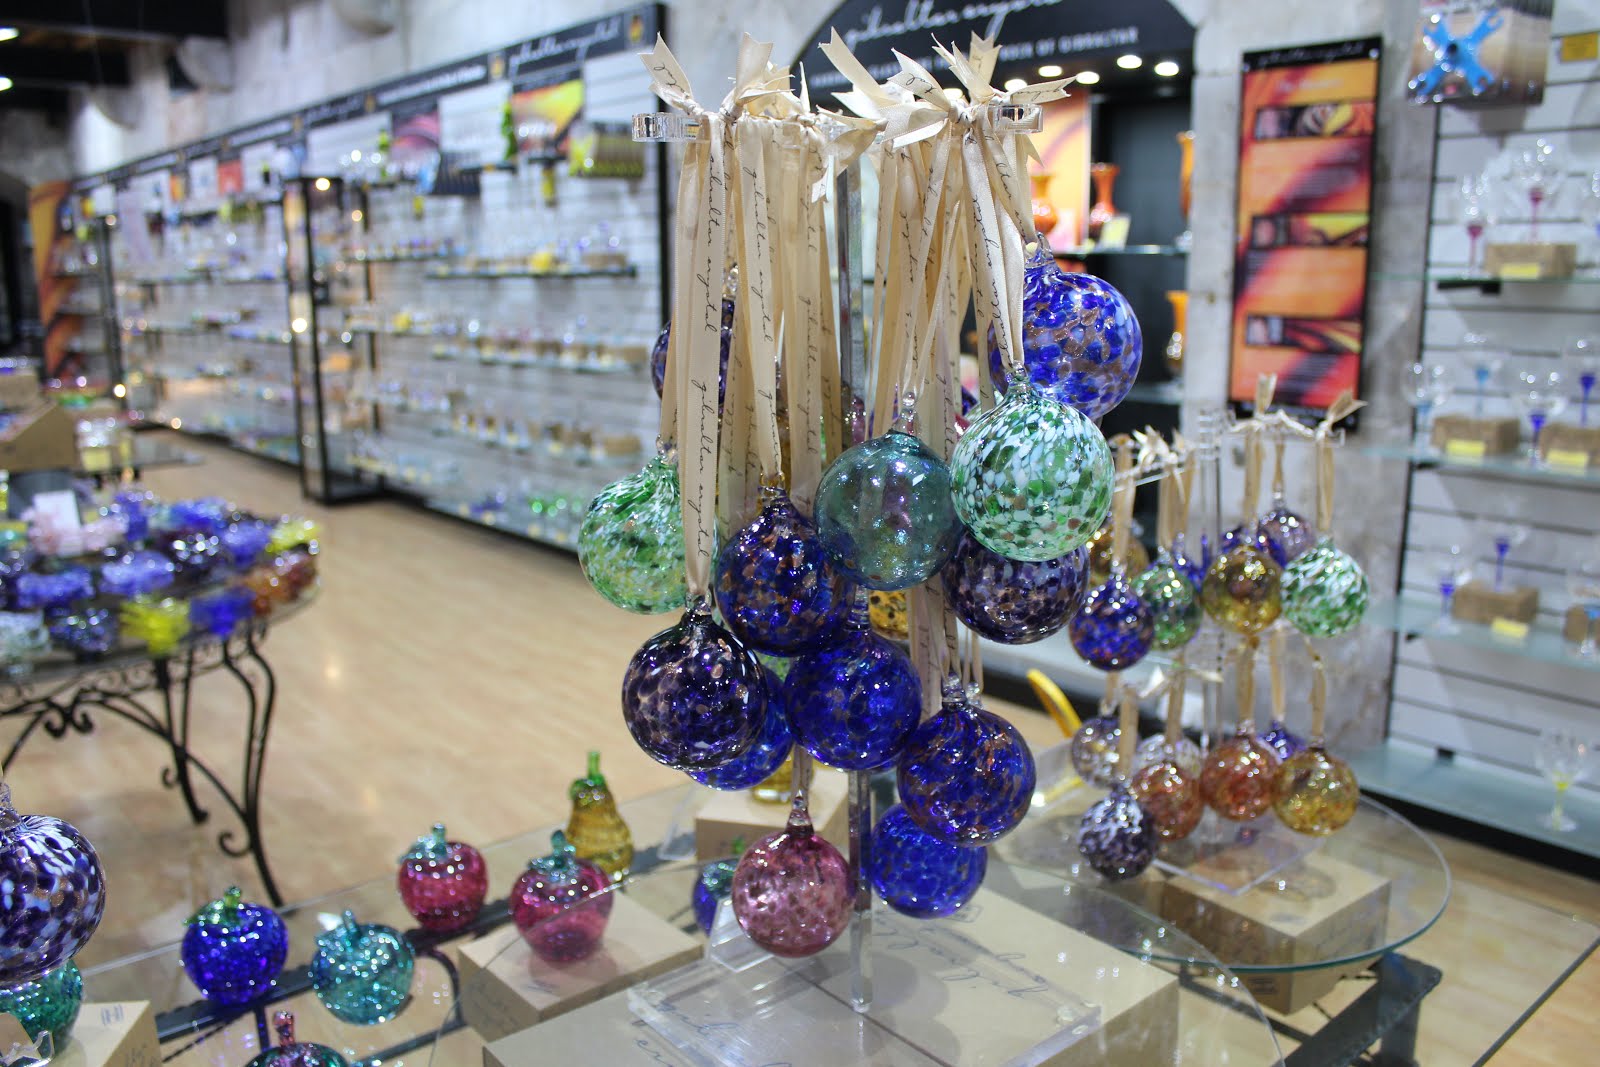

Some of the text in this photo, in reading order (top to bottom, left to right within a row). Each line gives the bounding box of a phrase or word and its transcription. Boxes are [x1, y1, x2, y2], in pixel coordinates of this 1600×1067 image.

[743, 166, 766, 259] gibraltar
[900, 210, 919, 284] crystal
[972, 193, 1000, 269] crystal
[696, 256, 718, 333] crystal
[750, 271, 774, 343] crystal
[797, 295, 818, 455] gibraltar crystal
[687, 378, 716, 558] gibraltar crystal
